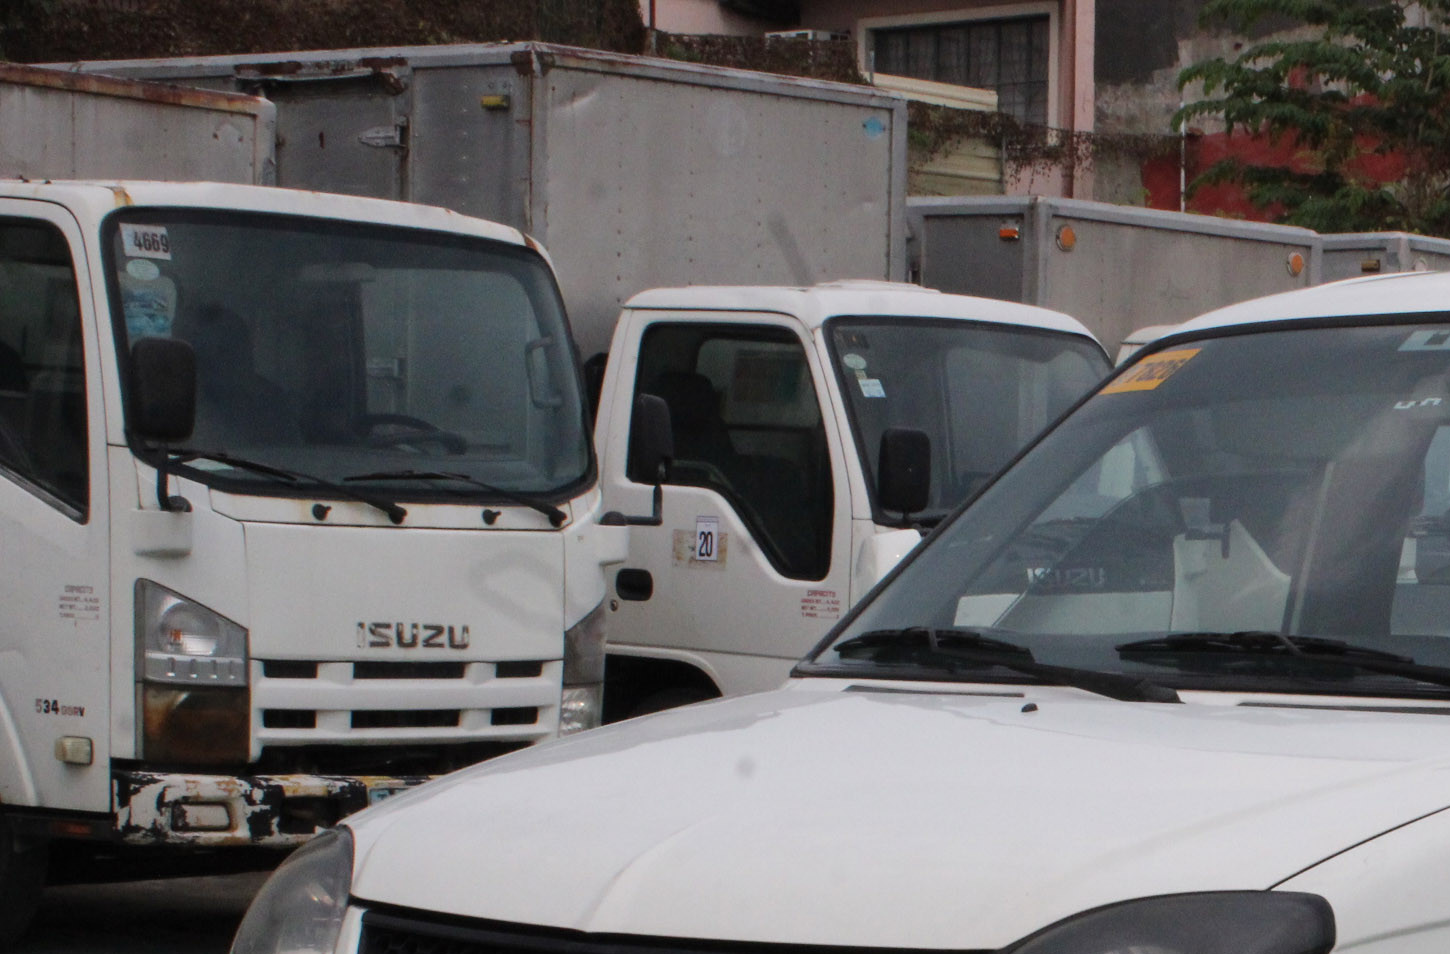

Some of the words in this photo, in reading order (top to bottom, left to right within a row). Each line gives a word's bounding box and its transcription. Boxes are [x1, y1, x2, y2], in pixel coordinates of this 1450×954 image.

[133, 231, 171, 253] 4669
[698, 531, 713, 557] 20
[356, 621, 470, 650] ISUZU
